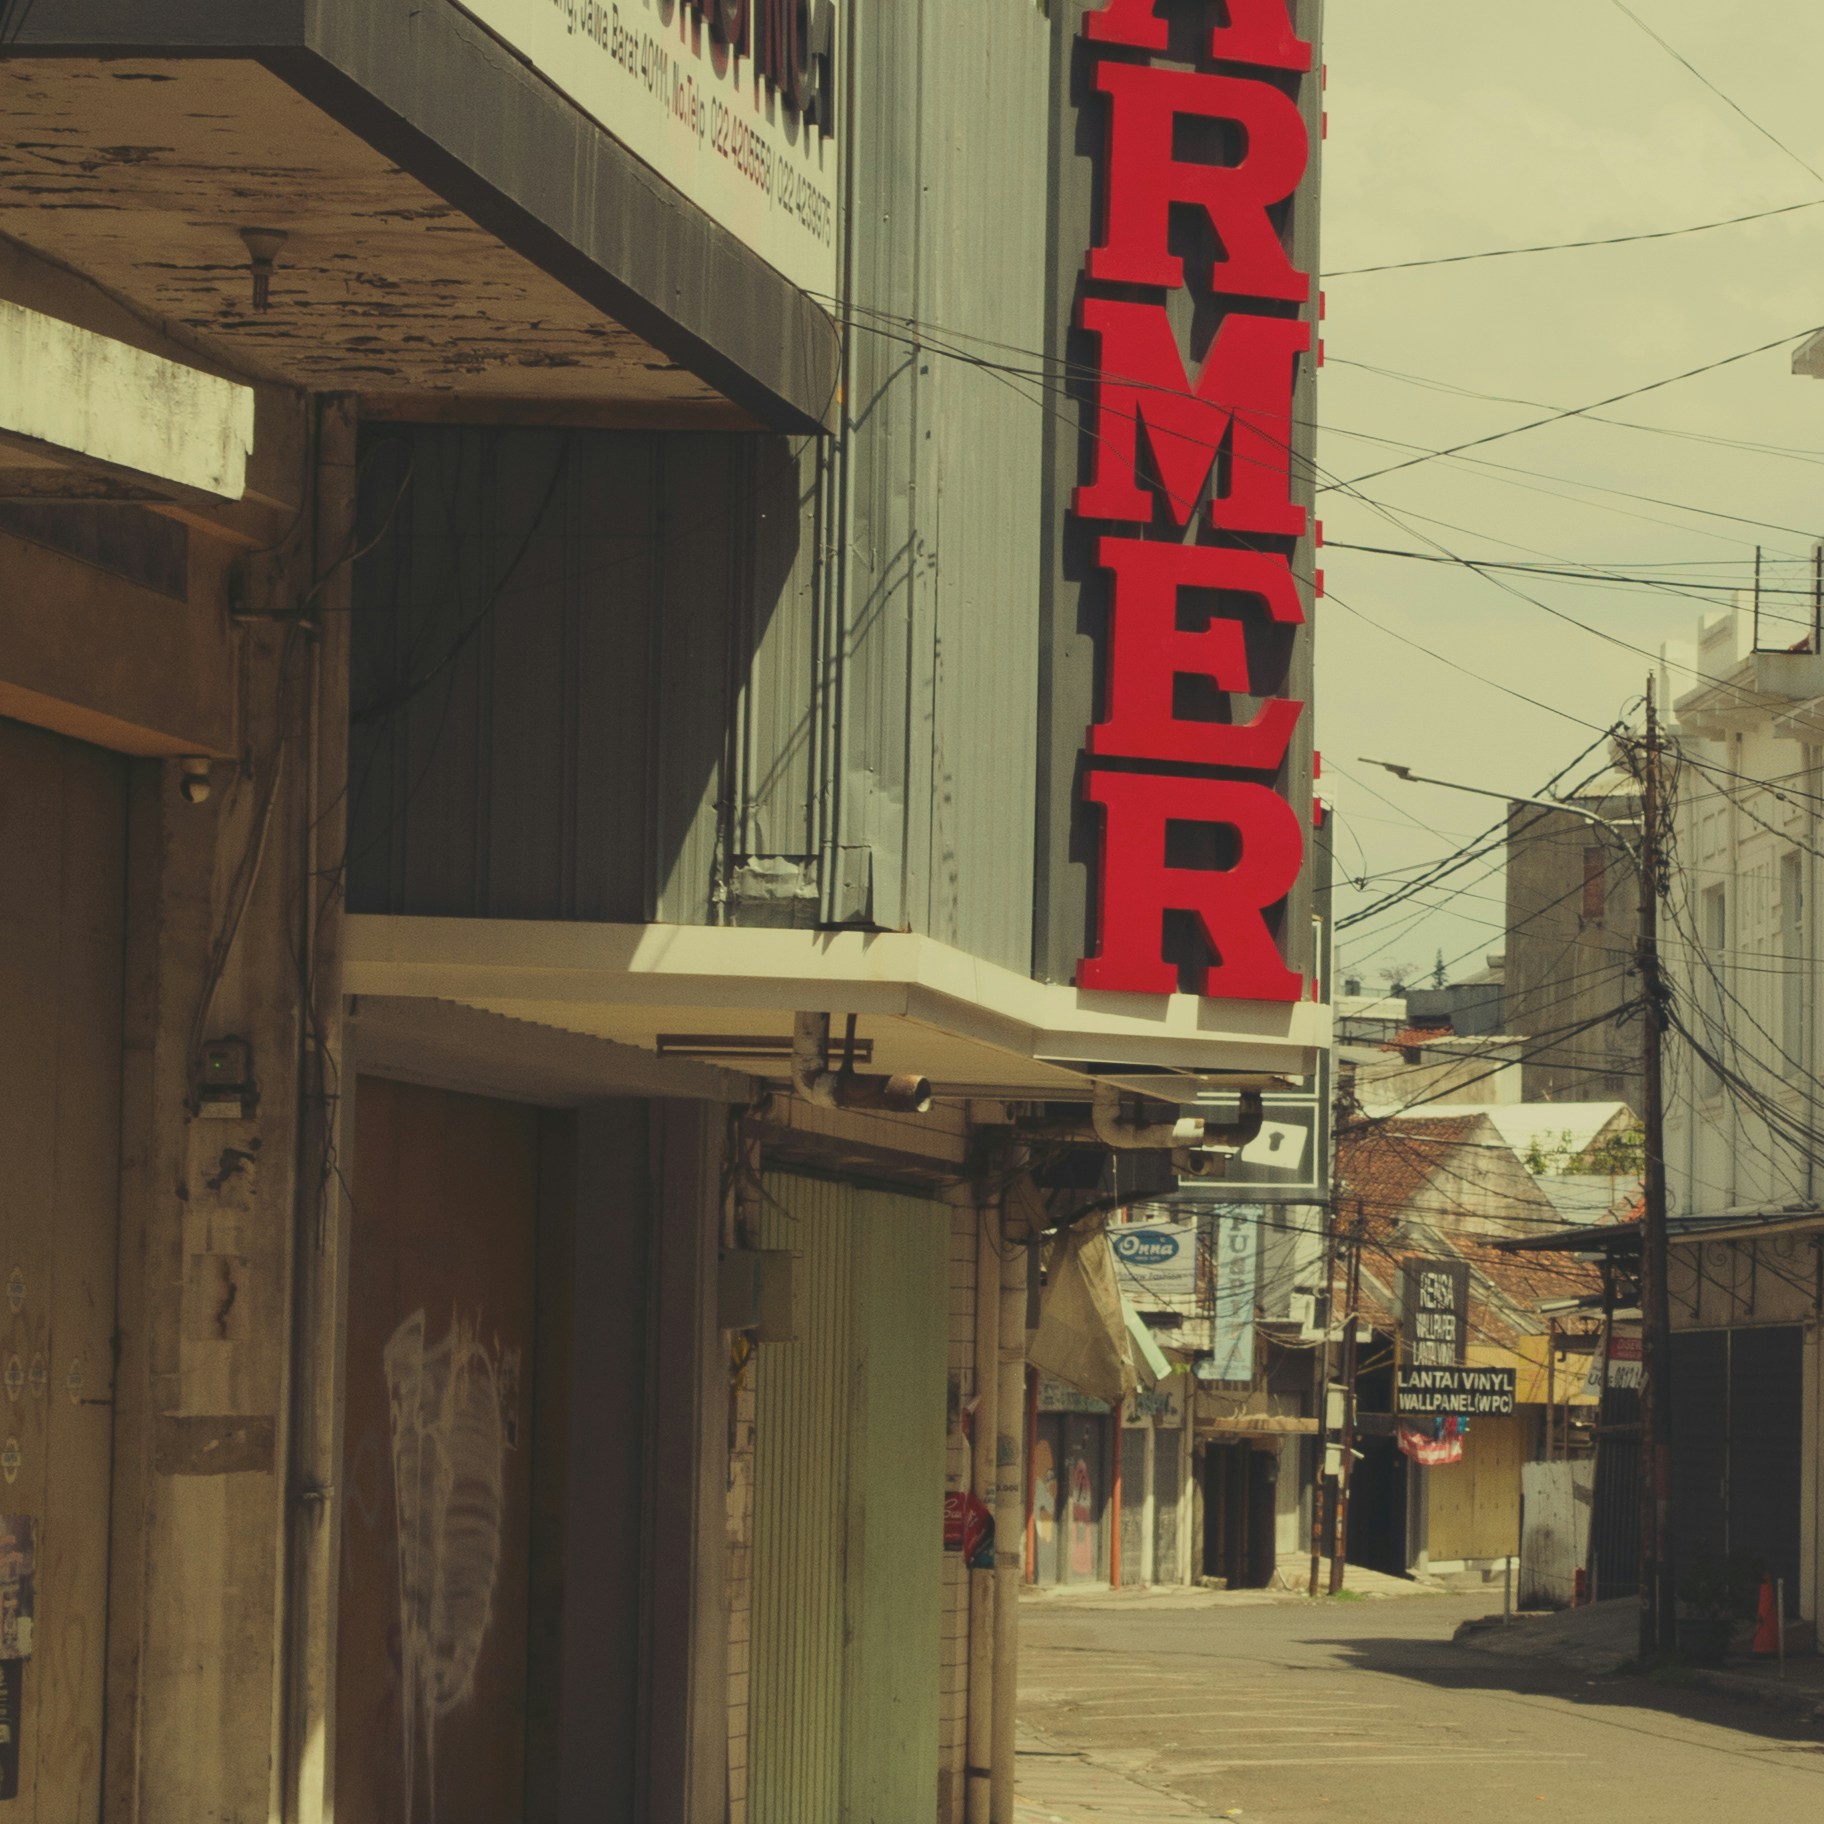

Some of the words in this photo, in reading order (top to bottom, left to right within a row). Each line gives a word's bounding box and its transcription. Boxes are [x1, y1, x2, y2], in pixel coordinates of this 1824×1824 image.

[611, 3, 640, 77] Barat
[710, 96, 729, 159] 022
[1118, 1235, 1173, 1256] Onna
[1398, 1370, 1459, 1389] LANTAI
[1464, 1372, 1513, 1391] VINYL
[1399, 1392, 1513, 1413] WALLPANEL(WPC)
